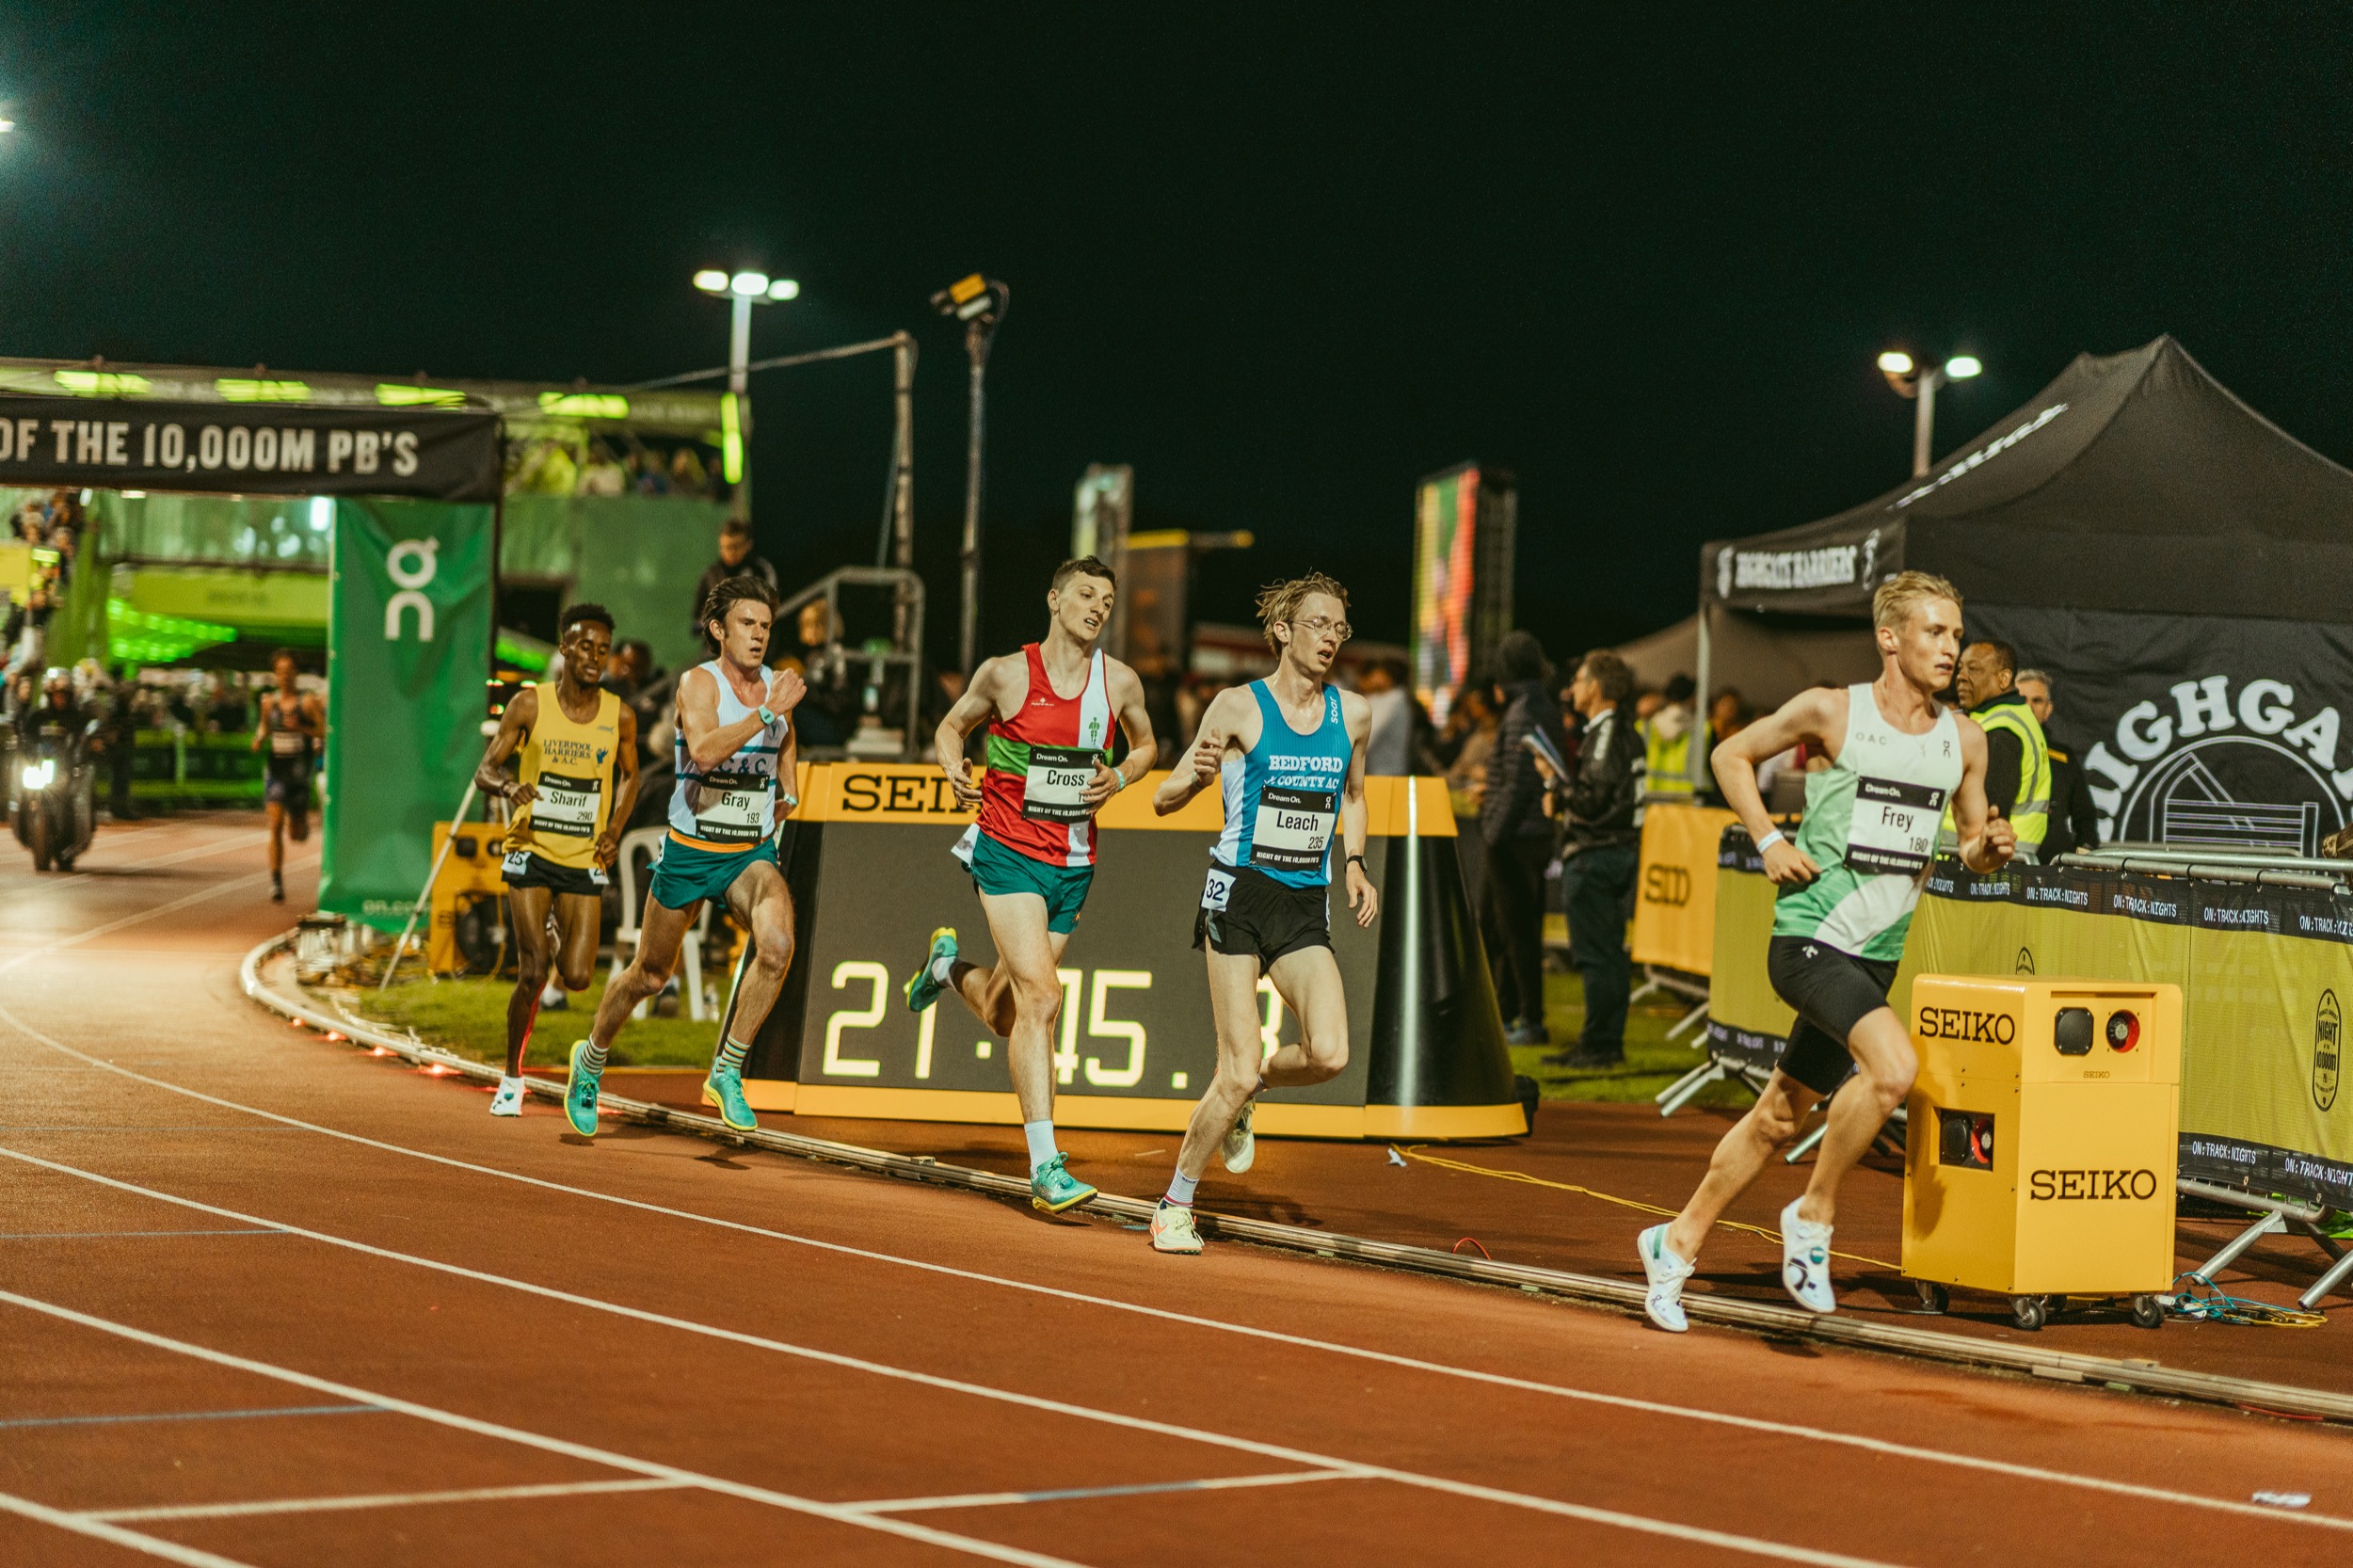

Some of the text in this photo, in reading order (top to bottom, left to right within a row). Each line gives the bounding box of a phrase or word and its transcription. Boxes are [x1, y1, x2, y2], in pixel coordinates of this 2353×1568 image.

[0, 417, 420, 477] OF THE 10,000M PB'S
[1329, 696, 1338, 724] soar
[544, 746, 591, 760] HARRIERS
[1036, 753, 1057, 761] Dream
[2084, 675, 2353, 843] IGHGA
[755, 757, 767, 775] C
[1268, 755, 1343, 773] BEDFORD
[709, 776, 728, 785] Dream
[1047, 769, 1085, 787] Cross
[1277, 775, 1326, 788] COUNTY
[1325, 776, 1340, 790] AC
[550, 791, 587, 808] Sharif
[721, 792, 750, 811] Gray
[842, 774, 984, 814] SEI
[1268, 792, 1302, 804] Dream On.
[576, 810, 593, 822] 290
[746, 812, 760, 824] 193
[1276, 810, 1319, 832] Leach
[1881, 806, 1914, 833] Frey
[1307, 836, 1324, 850] 235
[1909, 837, 1929, 853] 180
[1206, 878, 1225, 903] 32
[1919, 1006, 2015, 1046] SEIKO
[2083, 1070, 2110, 1079] SEIKO
[2030, 1169, 2157, 1201] SEIKO
